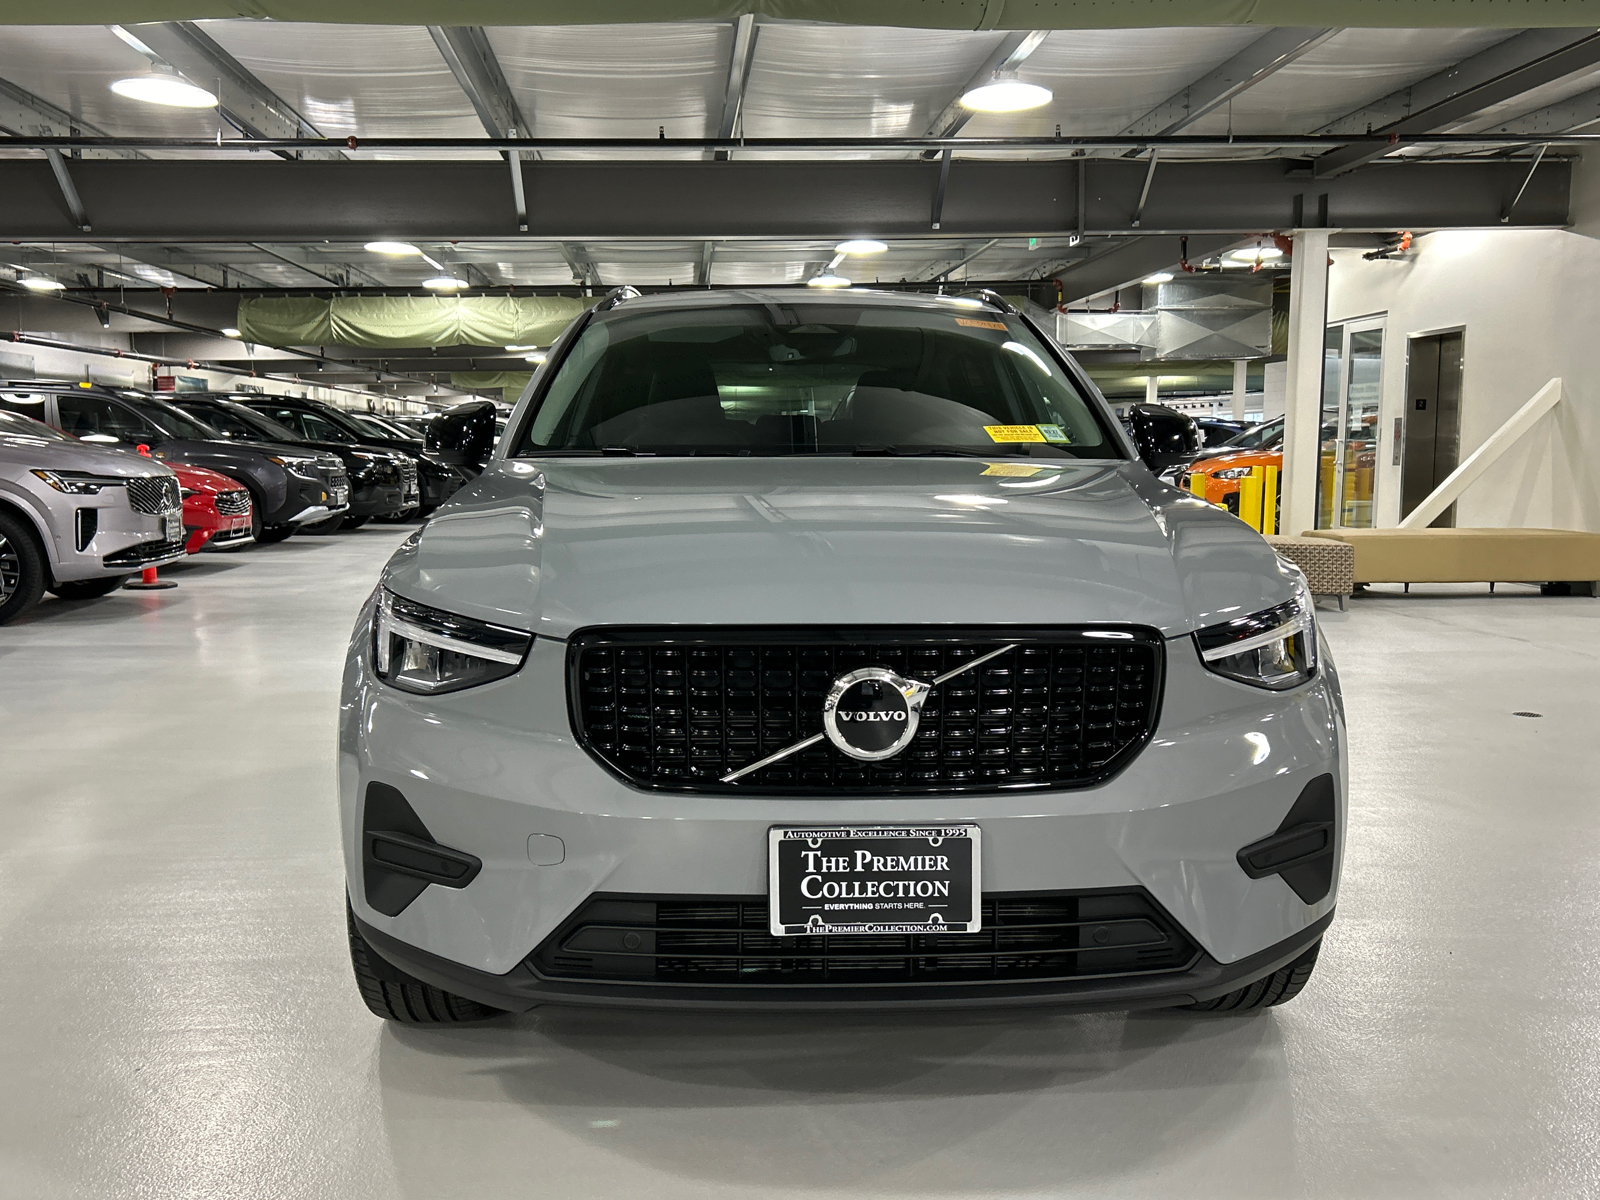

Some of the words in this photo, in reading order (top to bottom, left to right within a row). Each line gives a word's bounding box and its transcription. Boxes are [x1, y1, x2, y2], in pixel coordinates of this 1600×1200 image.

[838, 711, 906, 721] VOLVO
[786, 830, 847, 838] AUTOMOTIVE
[850, 829, 907, 838] EXCELLENCE
[909, 829, 937, 837] SINCE
[941, 829, 966, 837] 1995
[801, 851, 850, 873] THE
[854, 850, 950, 872] PREMIER
[801, 875, 950, 899] COLLECTION
[804, 924, 948, 933] THEPREMIERCOLLECTION.COM
